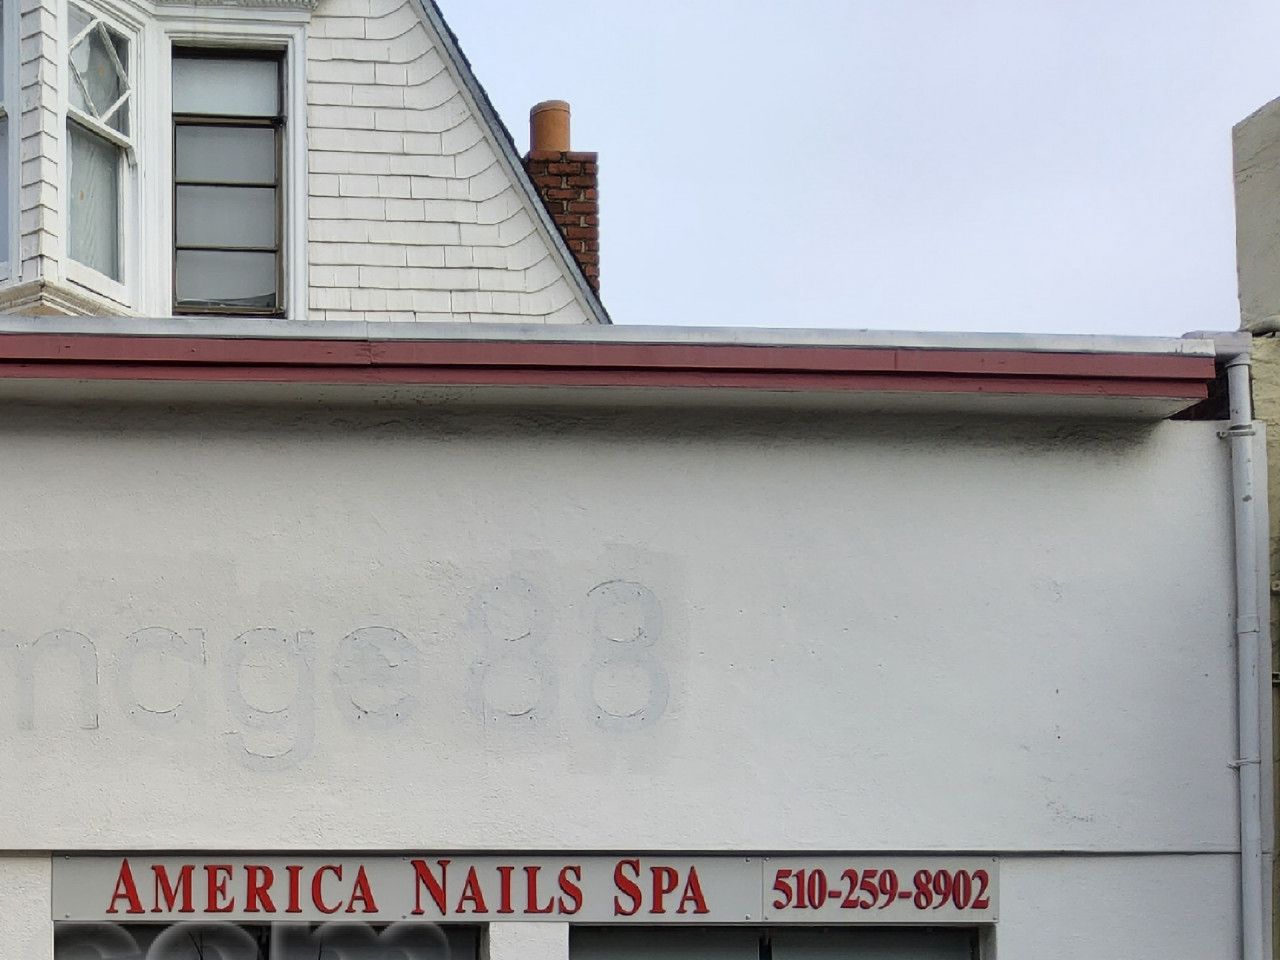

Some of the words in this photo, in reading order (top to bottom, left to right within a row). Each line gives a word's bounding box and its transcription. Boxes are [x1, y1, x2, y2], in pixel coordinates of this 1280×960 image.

[467, 570, 673, 733] 88
[105, 857, 380, 914] AMERICA
[410, 858, 583, 916] NAILS
[613, 858, 710, 915] SPA
[771, 867, 991, 910] 510-259-8902
